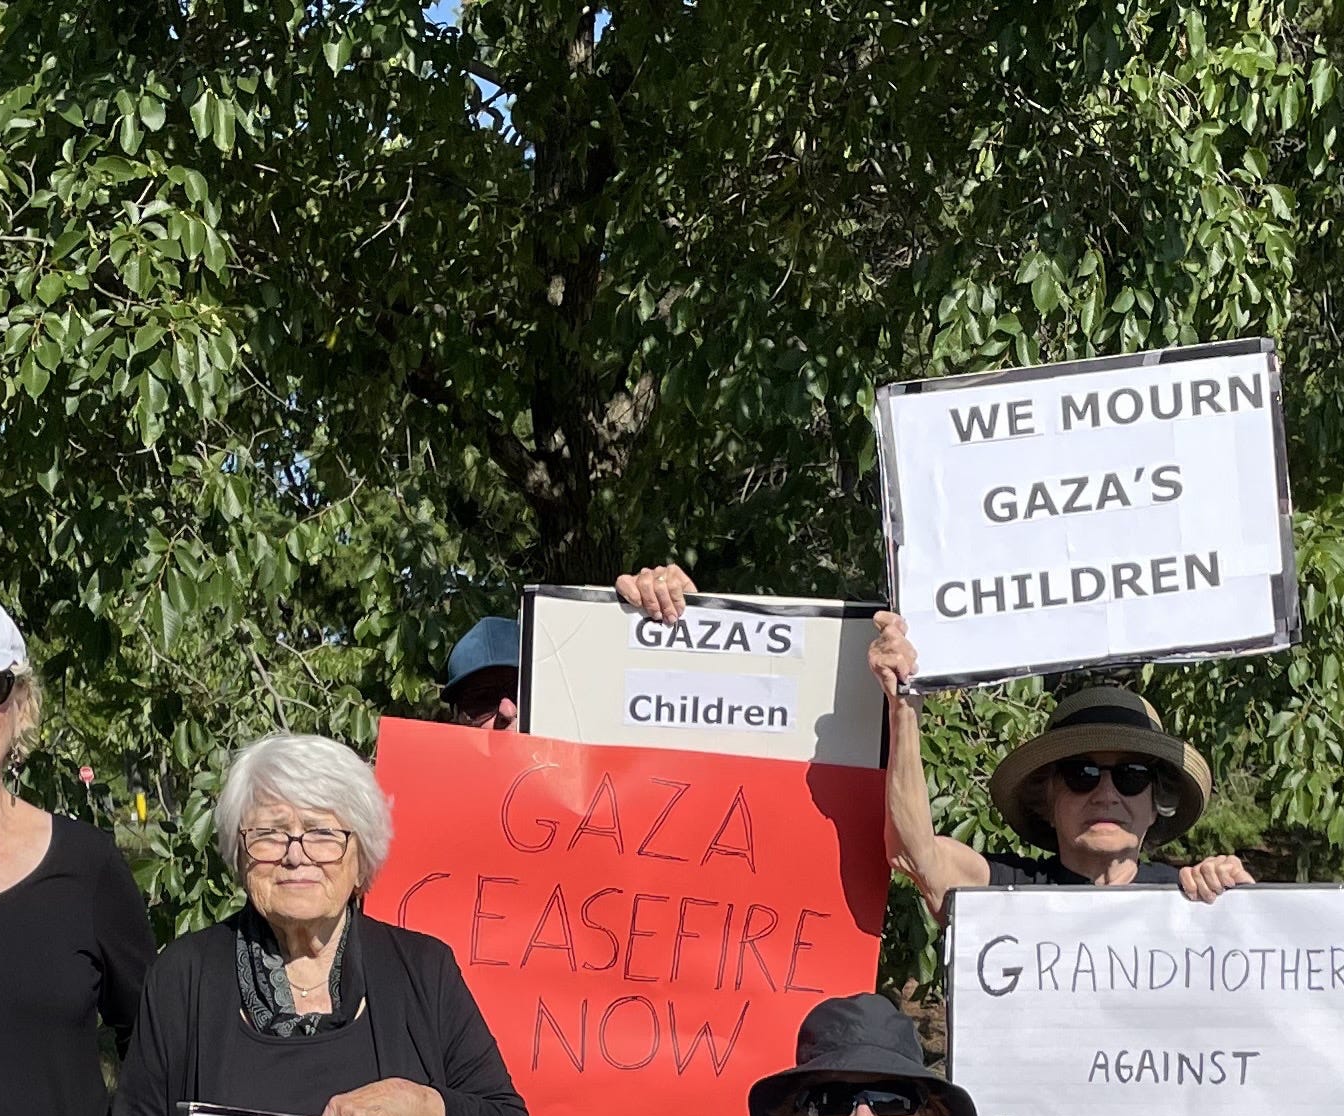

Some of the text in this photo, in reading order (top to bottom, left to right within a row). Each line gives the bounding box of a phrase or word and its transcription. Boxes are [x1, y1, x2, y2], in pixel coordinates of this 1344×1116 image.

[949, 373, 1265, 443] WE MOURN
[983, 464, 1184, 523] GAZA'S
[935, 550, 1222, 619] CHILDREN
[635, 616, 792, 654] GAZA'S
[629, 694, 788, 727] Children
[501, 764, 757, 874] GAZA
[532, 995, 751, 1077] NOW
[1088, 1049, 1261, 1086] AGAINST
